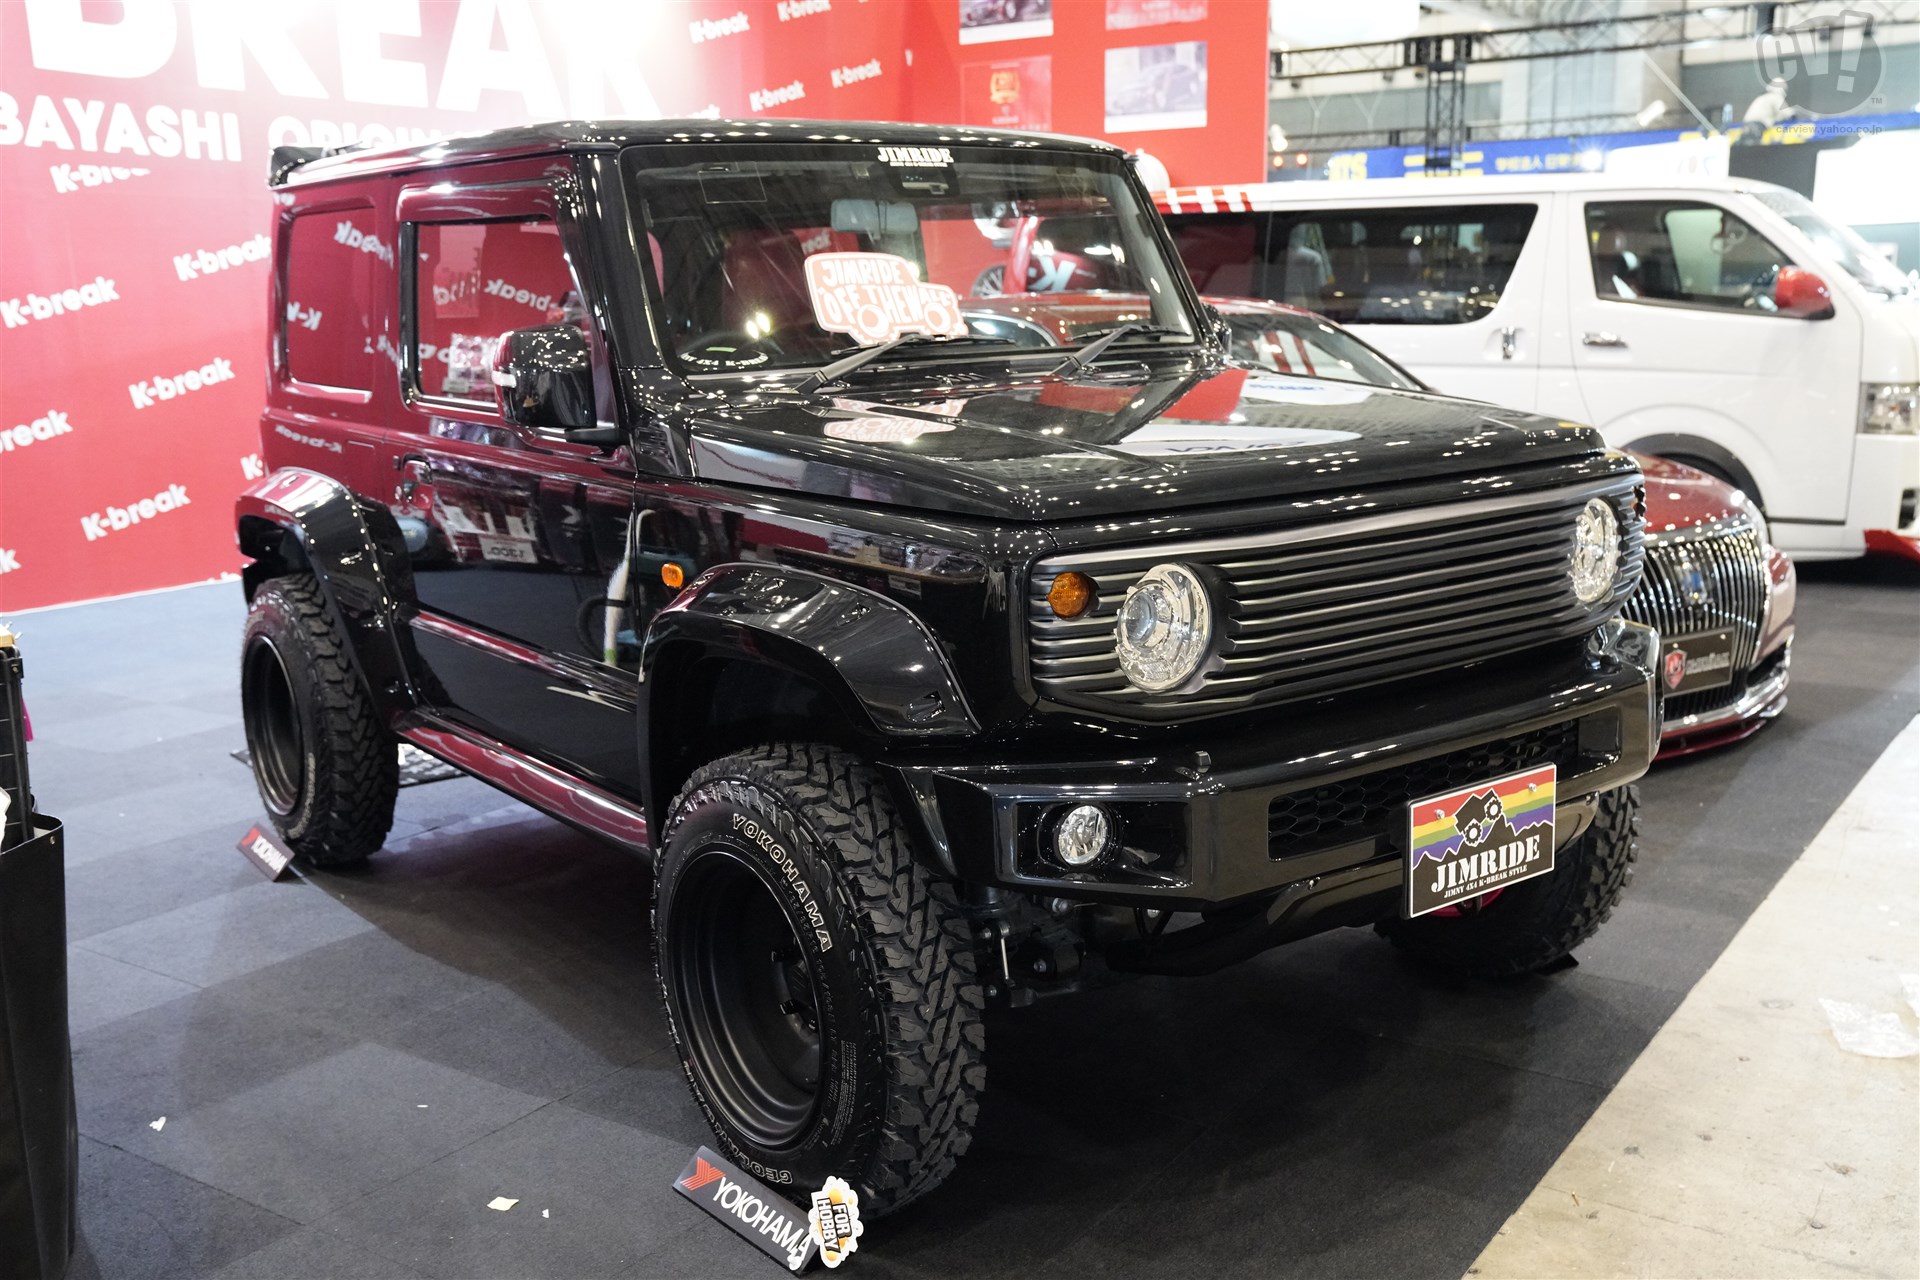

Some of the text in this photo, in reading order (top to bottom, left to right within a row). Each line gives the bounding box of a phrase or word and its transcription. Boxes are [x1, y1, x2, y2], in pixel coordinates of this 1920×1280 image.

[689, 11, 750, 44] K-break
[749, 80, 806, 112] K-break
[0, 91, 242, 162] BAYASHI
[877, 146, 955, 163] JIMRIDE
[172, 234, 272, 282] K-break
[821, 259, 905, 287] JIMRIDE
[0, 276, 120, 328] K-break
[128, 357, 236, 410] K-break
[0, 409, 73, 453] reak
[80, 483, 191, 542] K-break
[732, 813, 833, 952] YOKOHAMA
[1431, 834, 1540, 893] JIMRIDE
[1444, 864, 1528, 899] JIMNY 4X4 K-BREAK STYLE
[713, 1176, 814, 1262] YOKOHAMA
[817, 1198, 841, 1254] HOBBY
[832, 1203, 853, 1239] FOR
